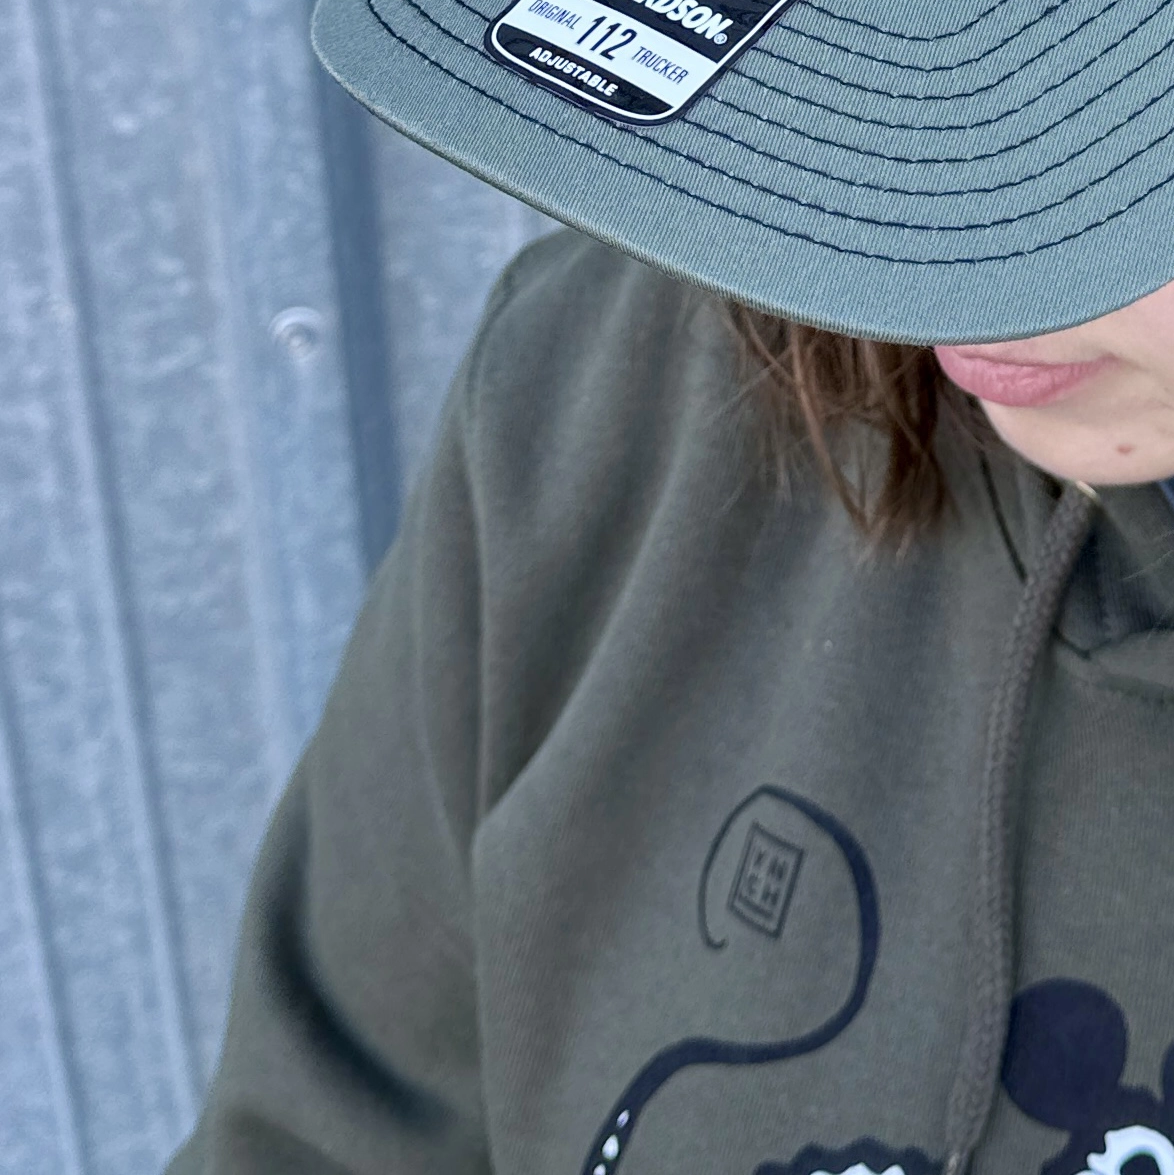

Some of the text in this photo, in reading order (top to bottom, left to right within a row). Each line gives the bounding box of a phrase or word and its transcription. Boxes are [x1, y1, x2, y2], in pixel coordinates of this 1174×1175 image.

[528, 47, 619, 97] ADJUSTABLE
[575, 15, 638, 61] 112
[631, 46, 689, 85] TRUCKER
